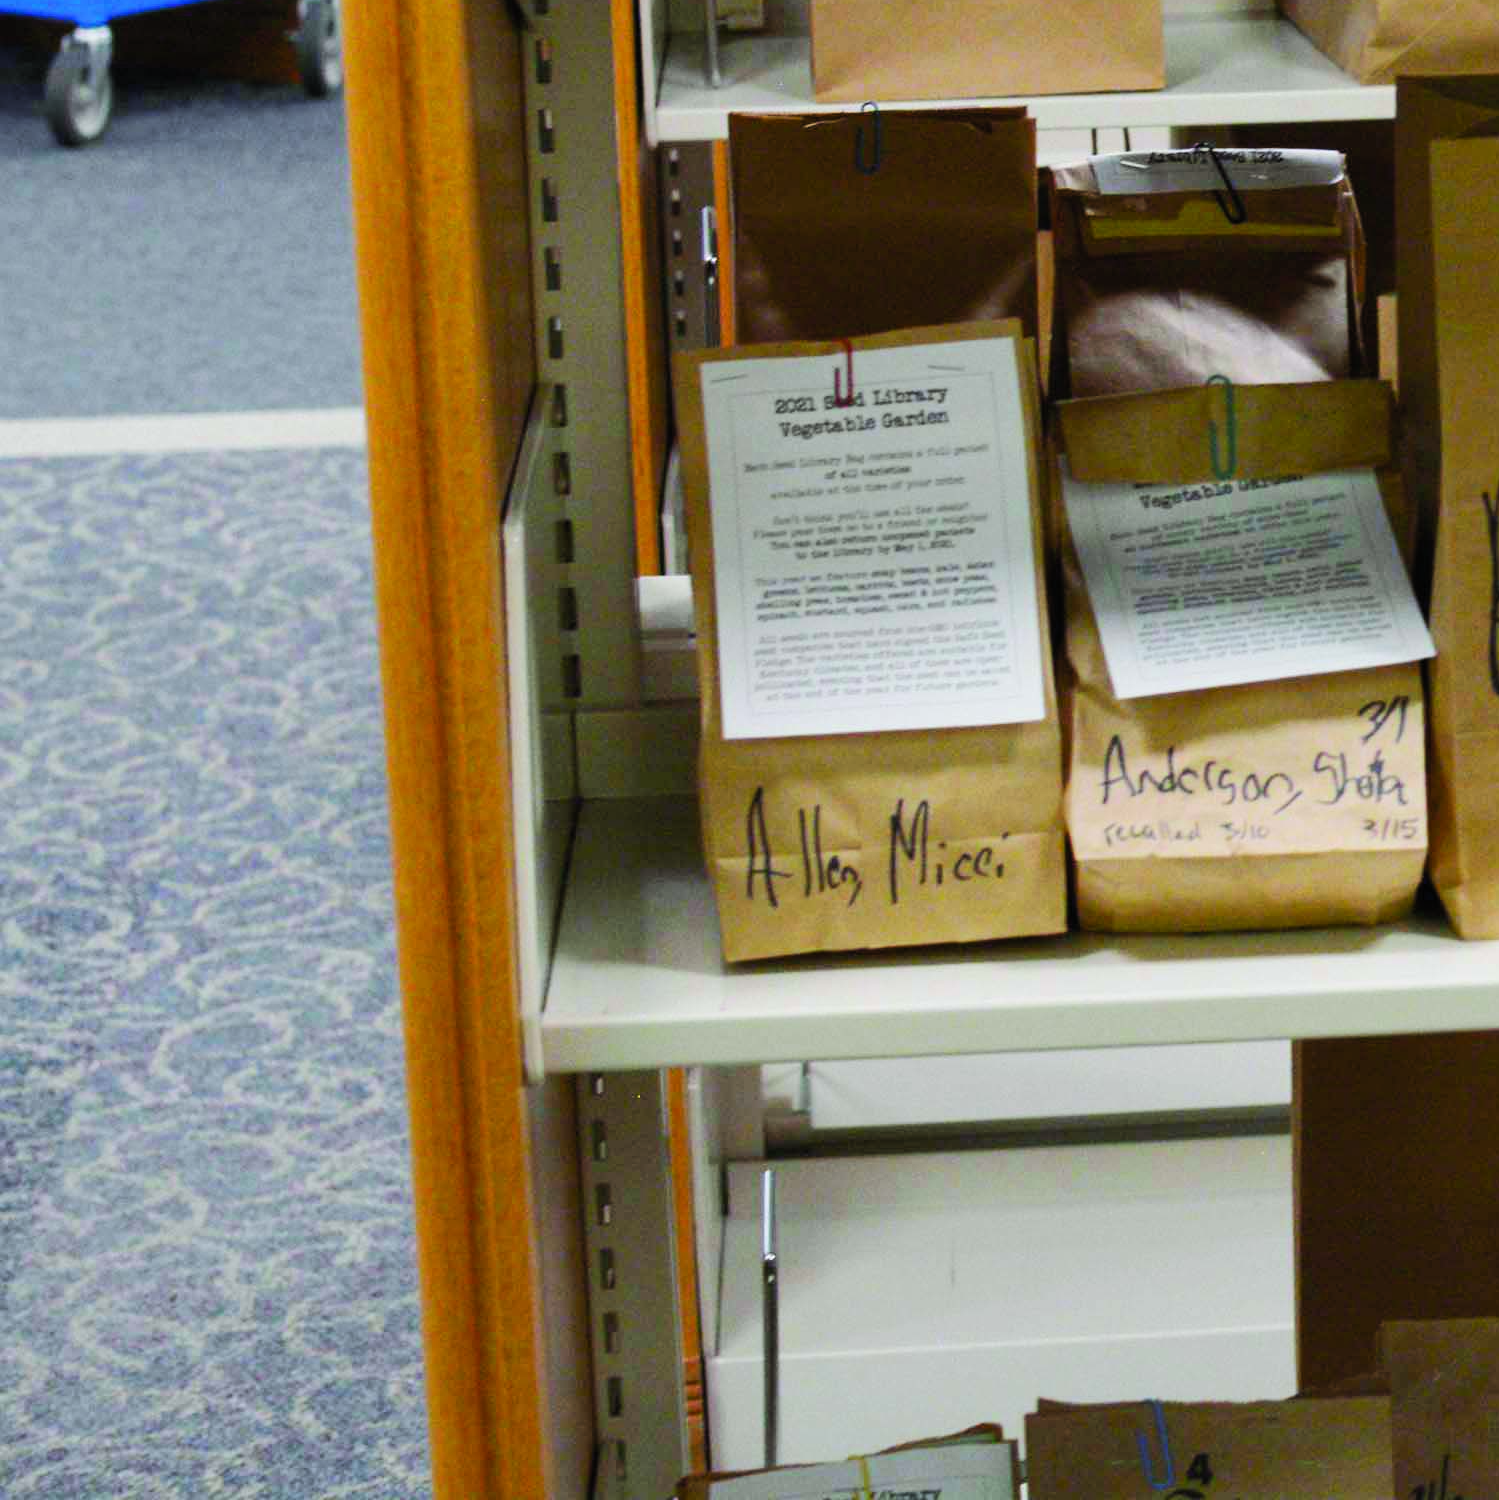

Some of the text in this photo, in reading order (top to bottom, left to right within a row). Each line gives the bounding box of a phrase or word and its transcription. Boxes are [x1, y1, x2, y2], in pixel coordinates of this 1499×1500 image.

[775, 387, 949, 415] 2021 Sd Library
[779, 409, 950, 440] Vegetable Garden
[1139, 479, 1233, 511] Vegetable
